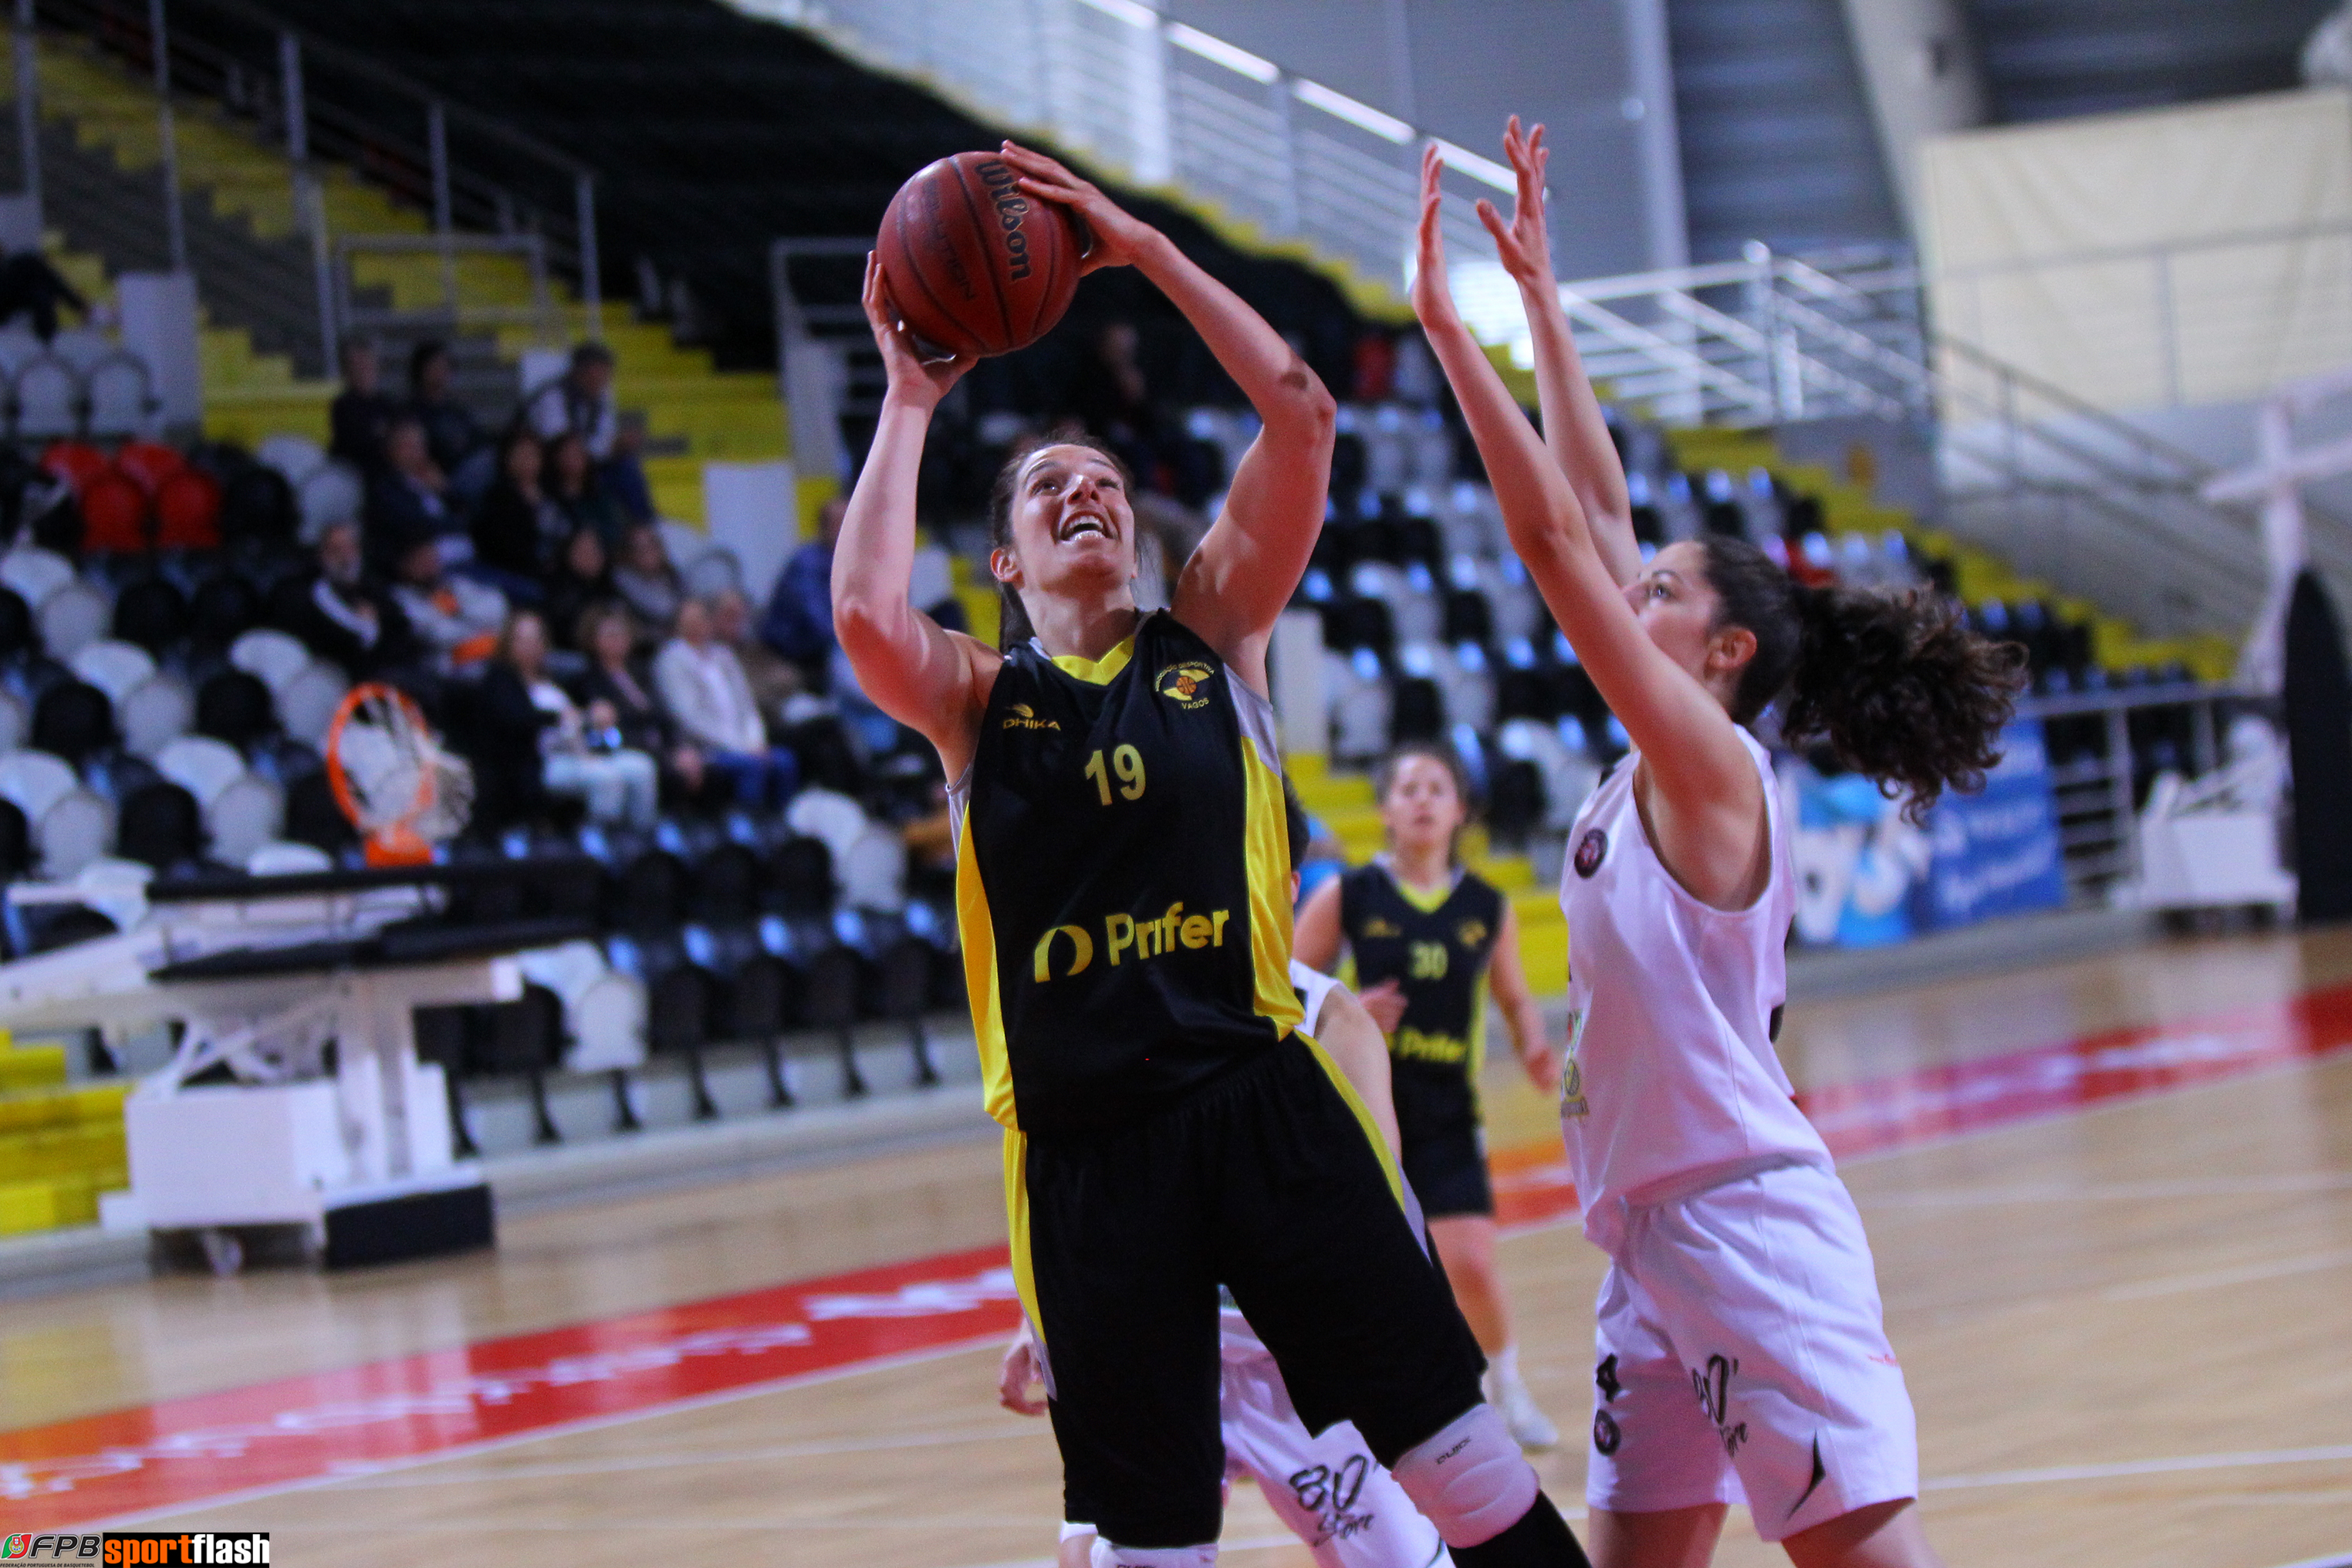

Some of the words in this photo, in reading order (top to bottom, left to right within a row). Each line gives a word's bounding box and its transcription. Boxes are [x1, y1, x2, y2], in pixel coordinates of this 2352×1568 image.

[975, 159, 1032, 282] Wilson
[1181, 697, 1210, 709] VAGOS
[1085, 743, 1147, 806] 19
[1105, 901, 1230, 966] Prifer
